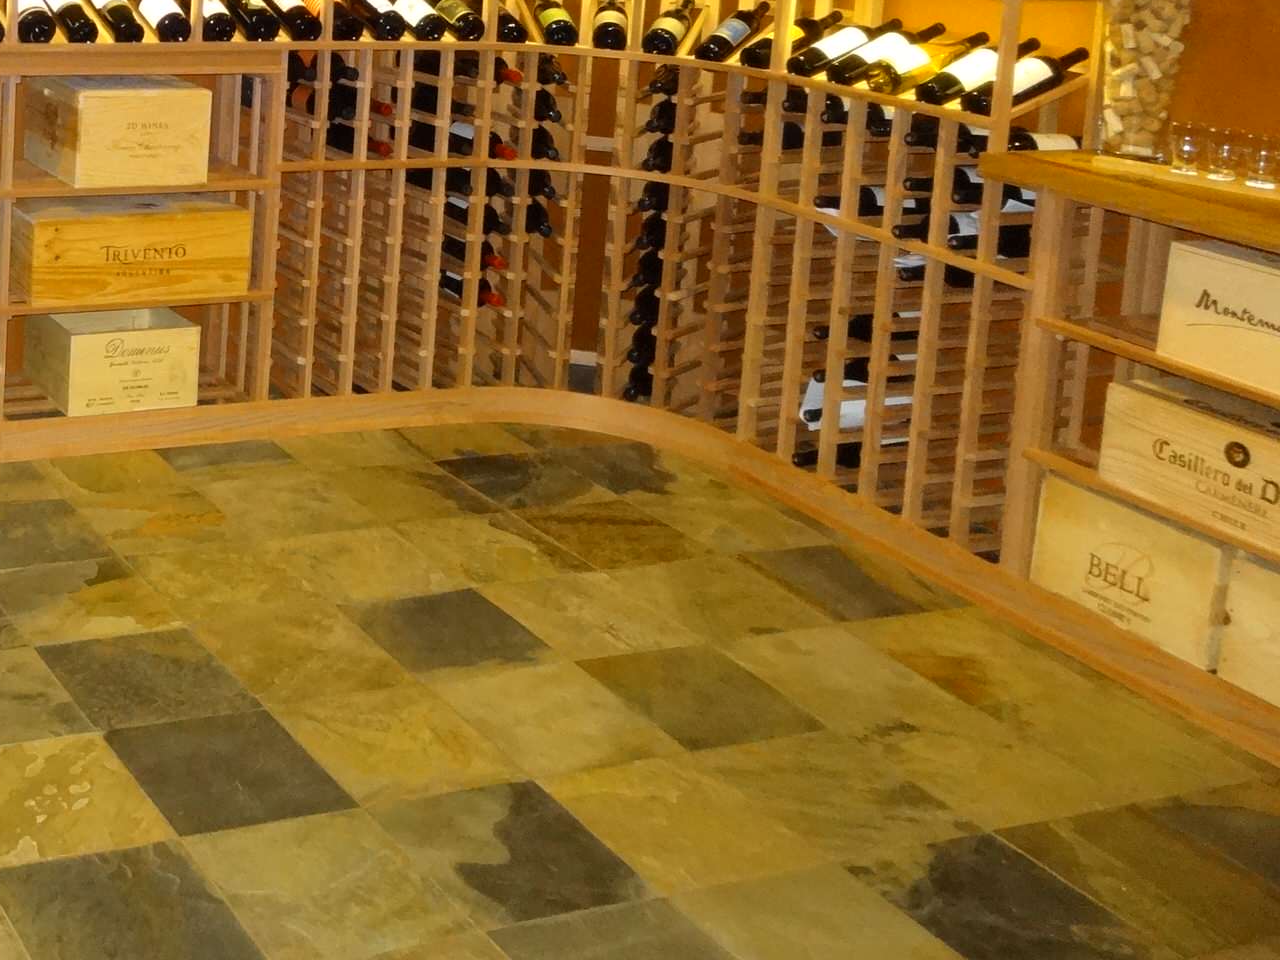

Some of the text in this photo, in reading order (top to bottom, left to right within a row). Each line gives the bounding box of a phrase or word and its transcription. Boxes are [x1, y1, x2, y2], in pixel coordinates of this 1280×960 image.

[100, 244, 187, 264] TRIVENTO
[1195, 288, 1280, 333] Montem
[1152, 438, 1231, 487] Casillero
[1235, 479, 1253, 496] del
[1088, 552, 1150, 602] BELL
